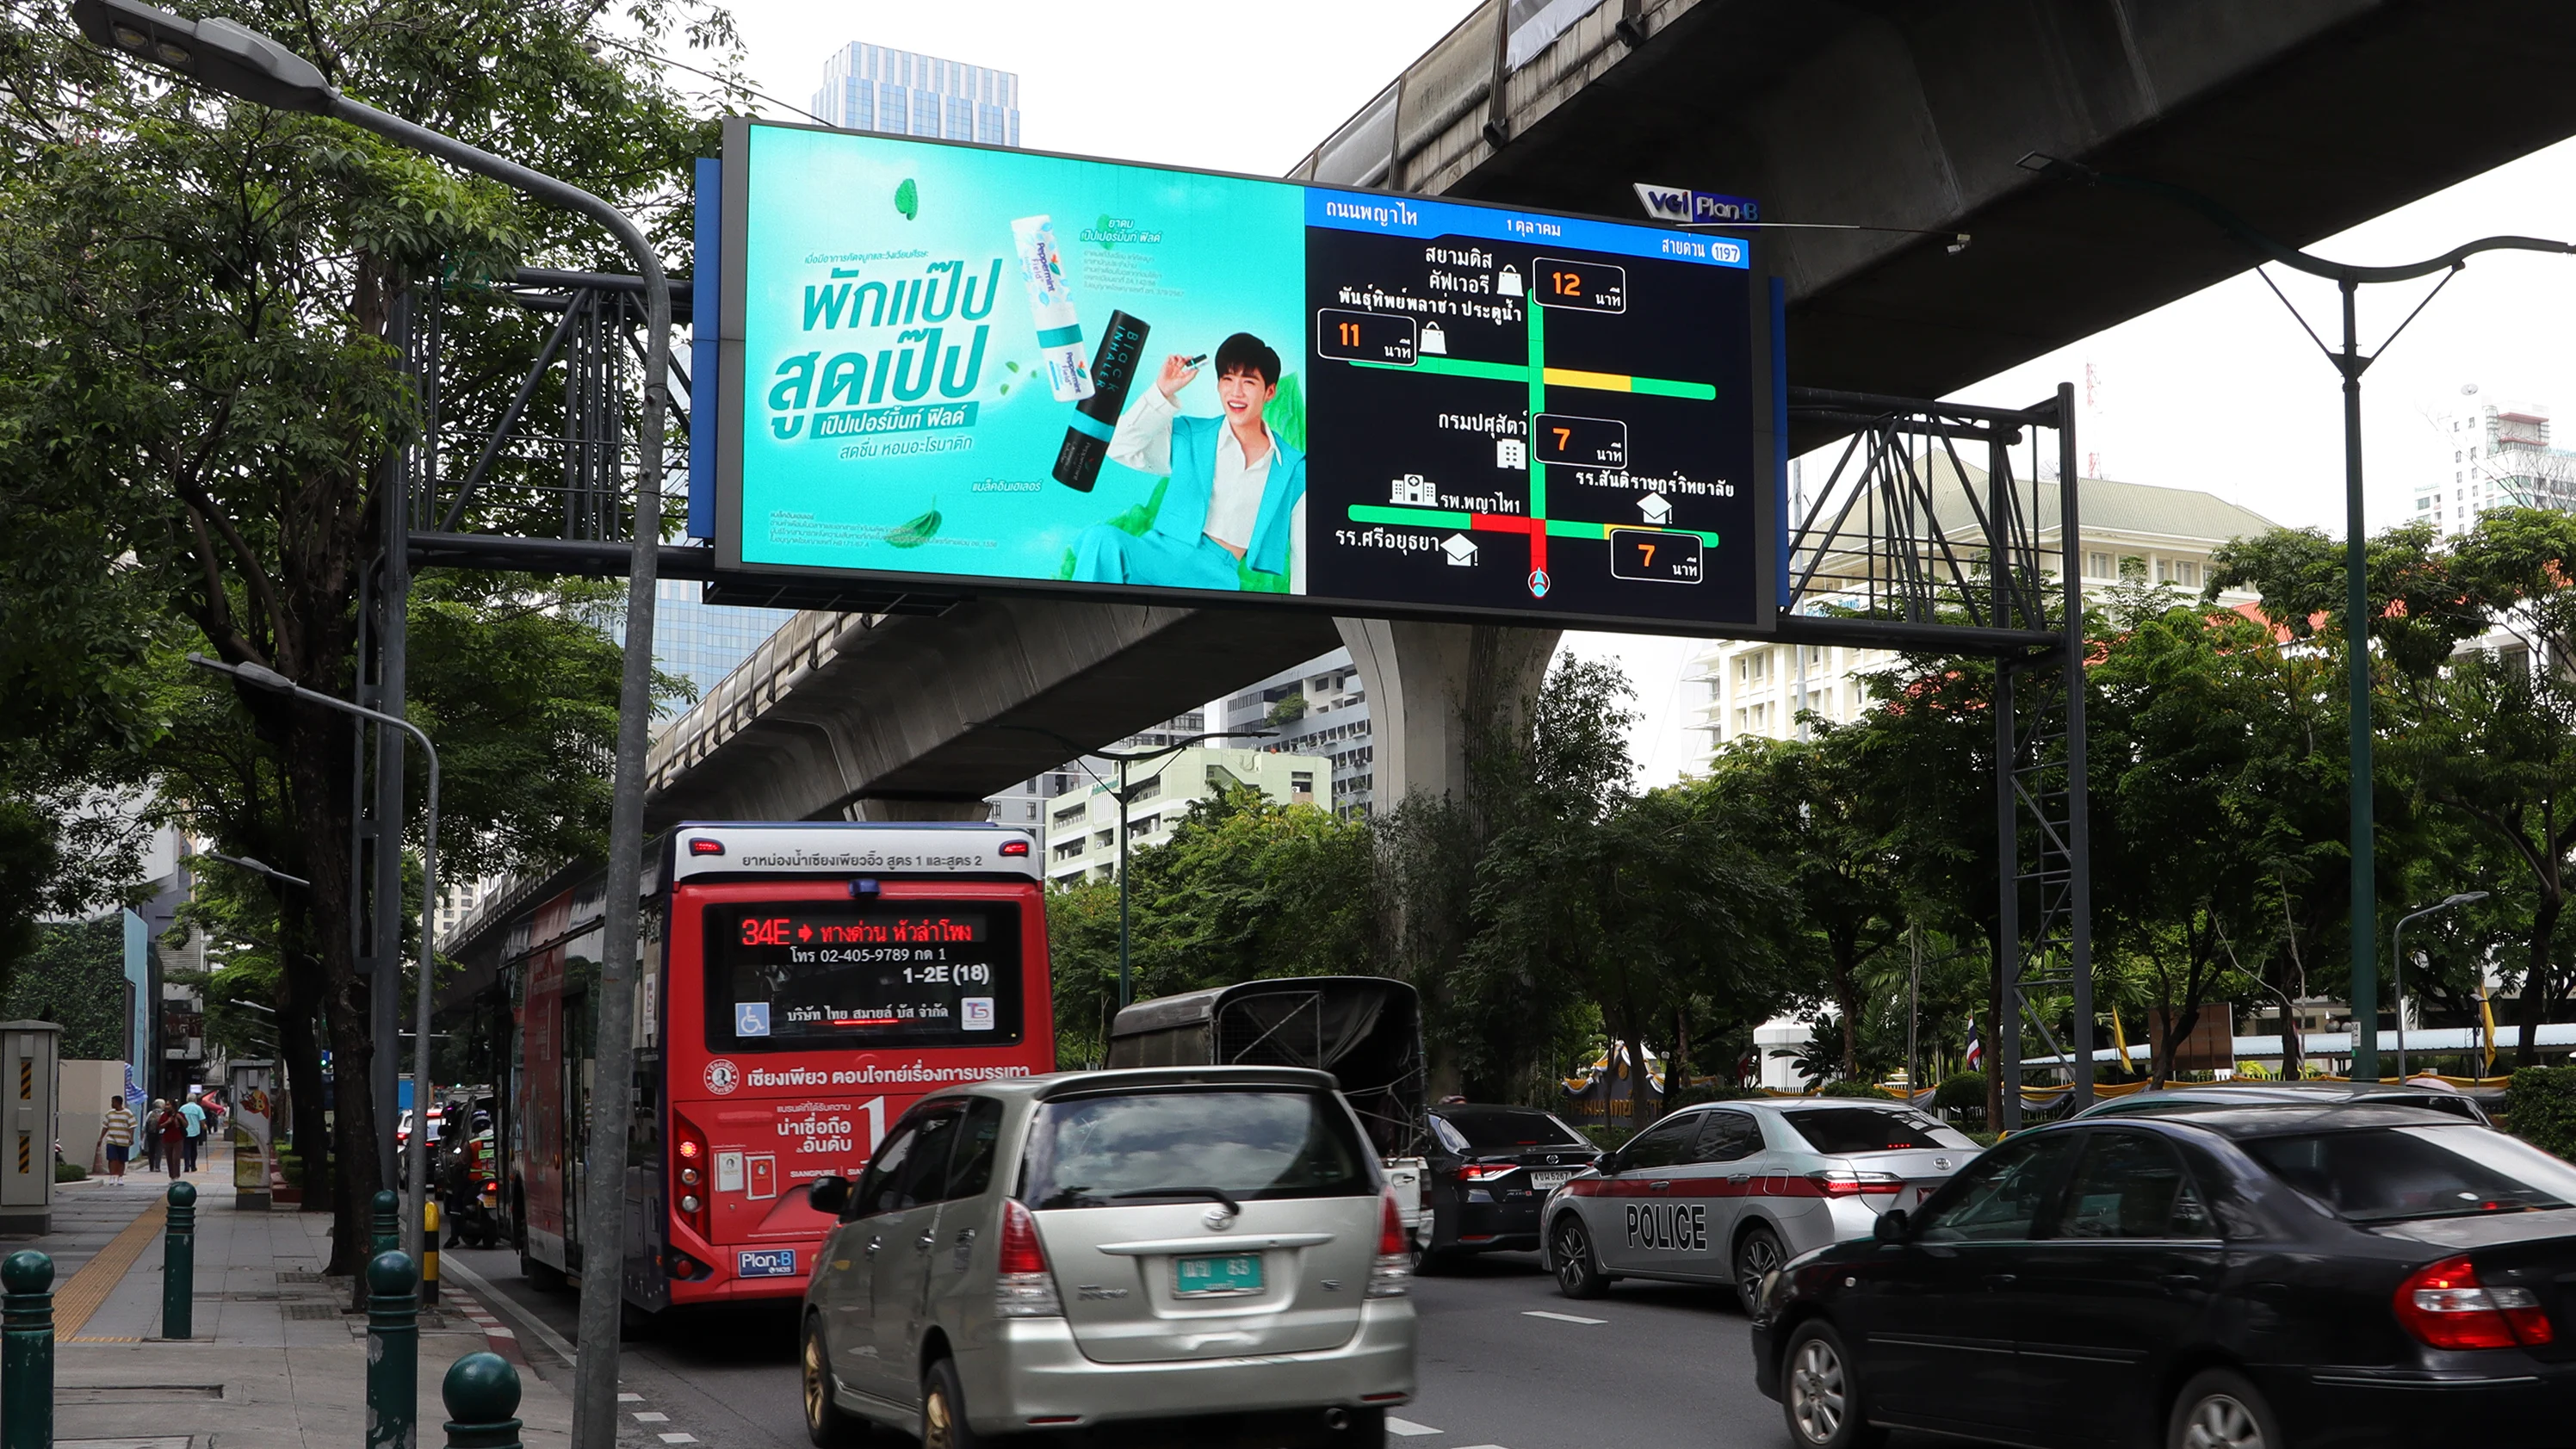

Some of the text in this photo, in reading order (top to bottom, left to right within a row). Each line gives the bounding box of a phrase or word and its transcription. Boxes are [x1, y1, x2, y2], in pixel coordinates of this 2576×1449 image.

[1325, 200, 1740, 263] ถนนพญาไท 1 ตุลาคม สายด่วน 1197
[1036, 242, 1056, 293] Peppermint
[1425, 247, 1493, 269] สยามดิส
[802, 258, 1003, 331] พักแป๊ป
[1428, 270, 1491, 295] คัฟเวอรี
[1551, 271, 1622, 308] 12 นาที
[1461, 299, 1522, 326] ประตูน้ำ
[1339, 322, 1411, 359] 11 นาที
[1096, 325, 1126, 389] INHALER
[767, 325, 990, 440] สูดเป๊ป
[1065, 351, 1081, 394] Peppermint
[820, 405, 968, 436] เป๊ปเปอร์มิ้นท์ ฟิลด์
[1437, 407, 1528, 437] กรมปศุสัตว์
[839, 435, 973, 460] สดชื่น หอมอะโรมาติก
[1552, 427, 1623, 463] 7 นาที
[972, 478, 1043, 492] แบล็คอินเฮเลอร์
[1576, 469, 1735, 498] รร.สันติราษฎร์วิทยาลัย
[1440, 491, 1520, 515] รพ.พญาไท1
[1334, 526, 1440, 556] รร.ศรีอยุธยา
[1637, 543, 1698, 577] 7 นาที
[887, 855, 912, 870] สูตร
[916, 856, 922, 866] 1
[926, 855, 971, 870] และสูตร
[975, 855, 982, 866] 2
[741, 919, 972, 945] 34E ทางด่วน หัวลำโพง
[790, 946, 945, 963] โทร 02-405-9789 กด 1
[902, 963, 990, 986] 1-2E (18)
[787, 1003, 949, 1022] บริษัท ไทย สมายล์ บัส จำกัด
[832, 1059, 1031, 1085] ตอบโจทย์เรื่องการบรรเทา
[777, 1113, 851, 1136] น่าเชื่อถือ
[803, 1136, 852, 1154] อันดับ
[790, 1169, 836, 1179] SIANGPURE
[1625, 1204, 1707, 1252] POLICE
